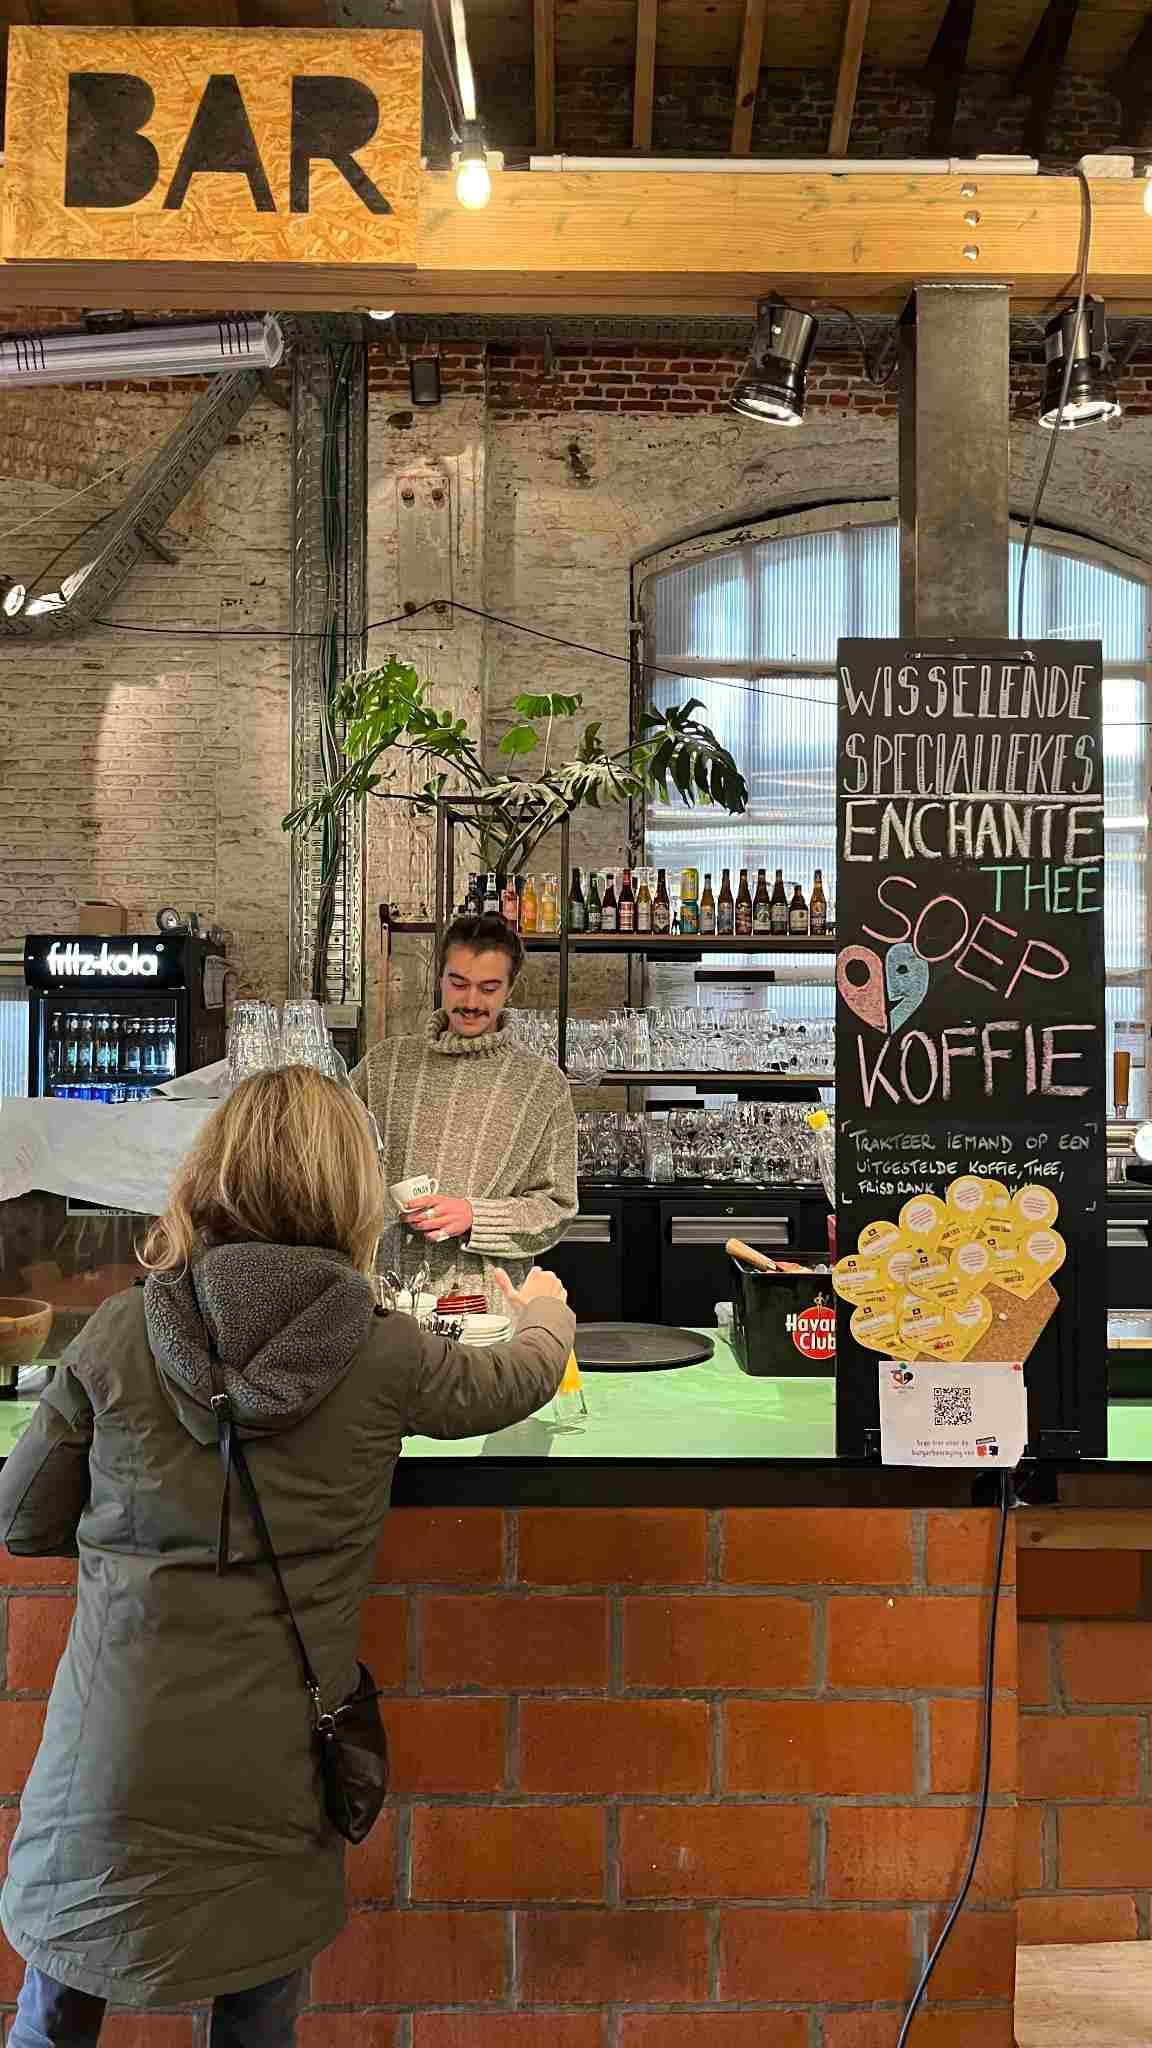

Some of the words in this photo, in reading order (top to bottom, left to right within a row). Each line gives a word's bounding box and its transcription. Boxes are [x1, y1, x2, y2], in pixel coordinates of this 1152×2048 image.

[64, 72, 396, 215] BAR
[839, 664, 1095, 719] WISSELENDE
[843, 733, 1096, 795] SPECIALLEKES
[843, 800, 1104, 863] ENCHANTE
[979, 864, 1102, 913] THEE
[861, 875, 1070, 998] SOEP
[857, 1019, 1097, 1108] KOFFIE
[1025, 1133, 1048, 1150] OP
[1058, 1134, 1090, 1150] EEN
[1023, 1158, 1065, 1184] THEE,
[785, 1313, 837, 1332] Hava
[800, 1332, 837, 1350] Club
